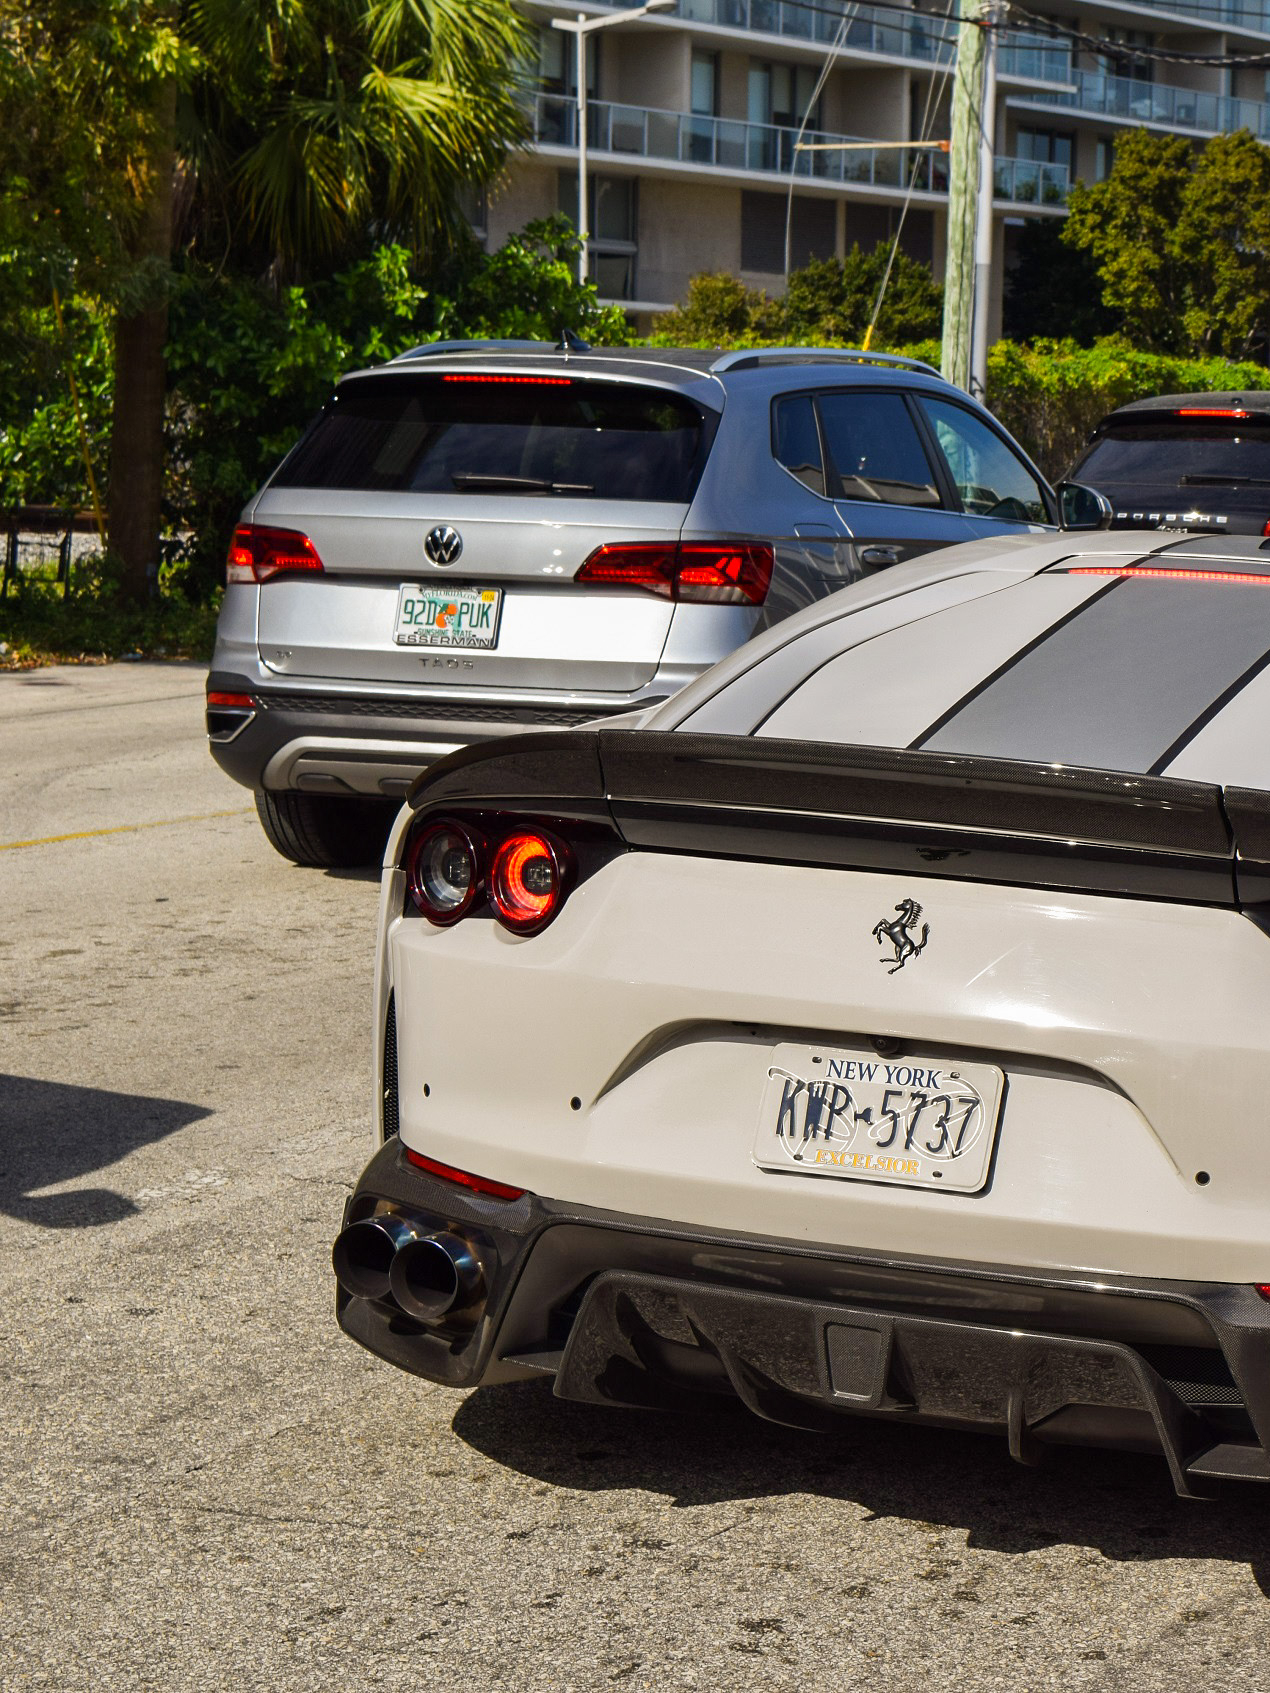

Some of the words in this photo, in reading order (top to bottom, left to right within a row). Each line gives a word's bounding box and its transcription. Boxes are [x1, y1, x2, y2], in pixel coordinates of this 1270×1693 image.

[1117, 512, 1227, 524] PORSCHE
[402, 599, 437, 626] 92D
[458, 602, 492, 628] PUK
[397, 635, 490, 648] ESSERMAN
[419, 658, 474, 669] TAOS
[826, 1059, 879, 1082] NEW
[884, 1065, 942, 1090] YORK
[876, 1090, 980, 1159] 5737
[815, 1149, 920, 1176] EXCELSIOR
